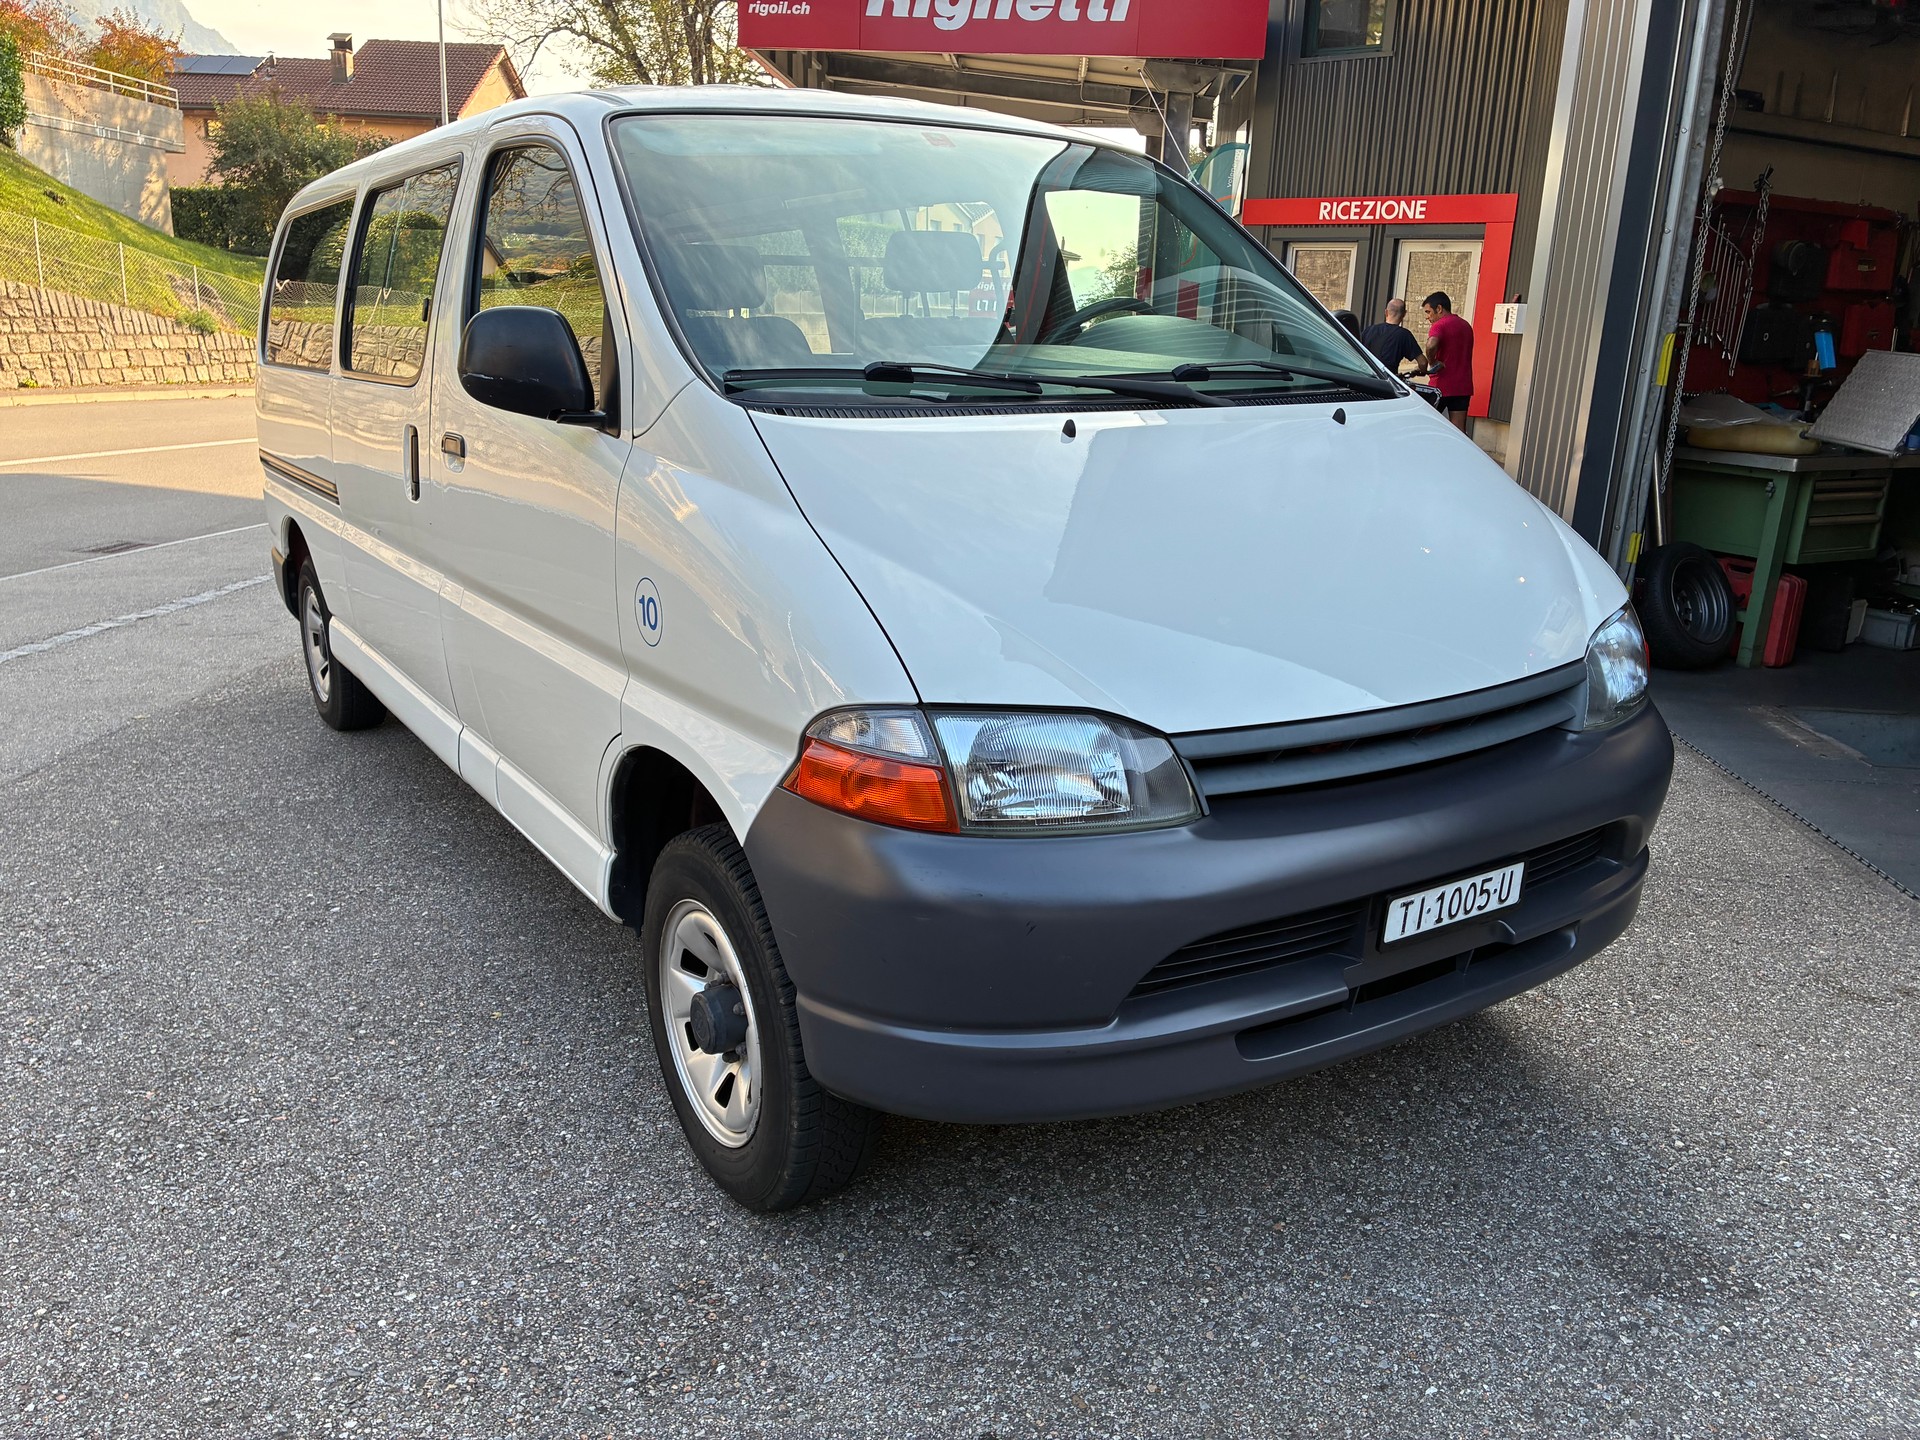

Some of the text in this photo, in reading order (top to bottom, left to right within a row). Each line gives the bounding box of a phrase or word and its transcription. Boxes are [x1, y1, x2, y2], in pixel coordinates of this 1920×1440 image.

[748, 1, 811, 17] rigoil.ch
[1319, 200, 1427, 220] RICEZIONE
[639, 594, 658, 631] 10
